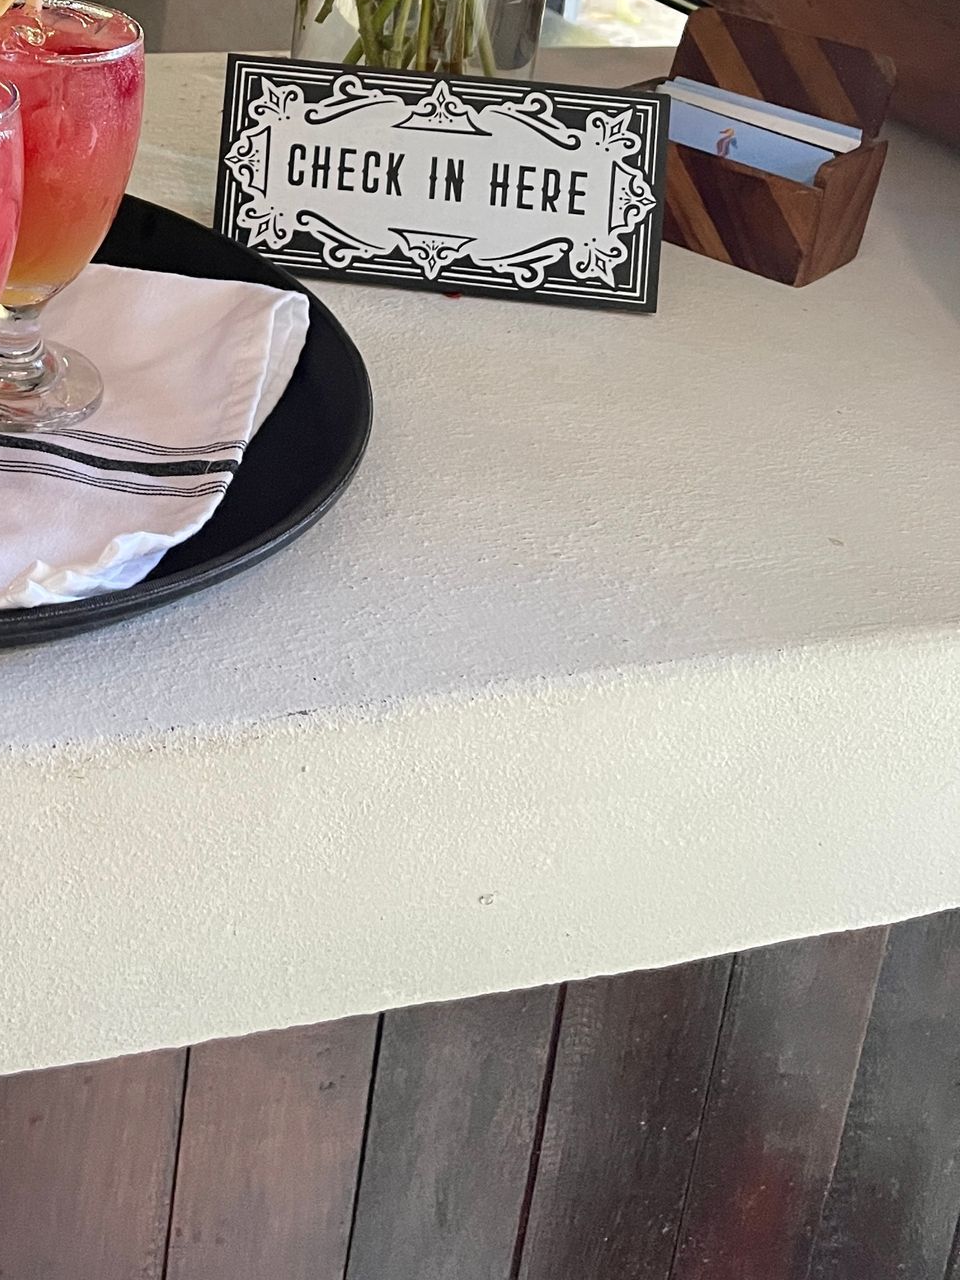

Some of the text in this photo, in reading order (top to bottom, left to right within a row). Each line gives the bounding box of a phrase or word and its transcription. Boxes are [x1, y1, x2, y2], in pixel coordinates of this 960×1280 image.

[287, 143, 588, 216] CHECK IN HERE
